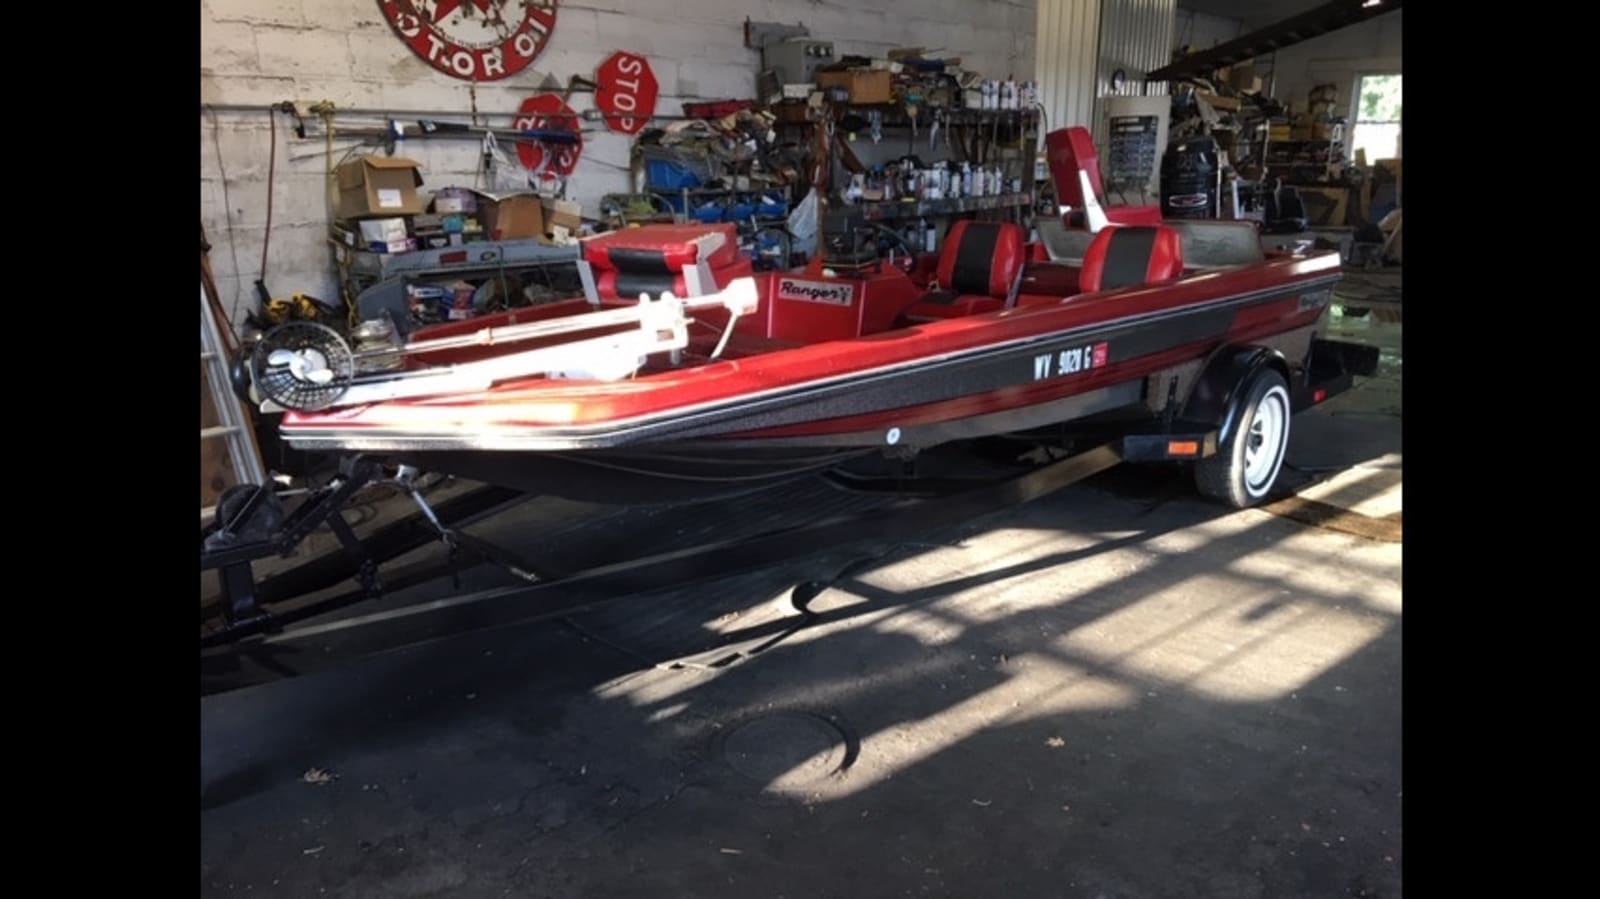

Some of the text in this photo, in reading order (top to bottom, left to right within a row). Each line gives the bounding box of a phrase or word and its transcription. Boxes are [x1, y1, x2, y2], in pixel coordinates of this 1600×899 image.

[383, 0, 505, 77] OTOR
[612, 56, 642, 131] STOP
[781, 281, 838, 300] Ranger
